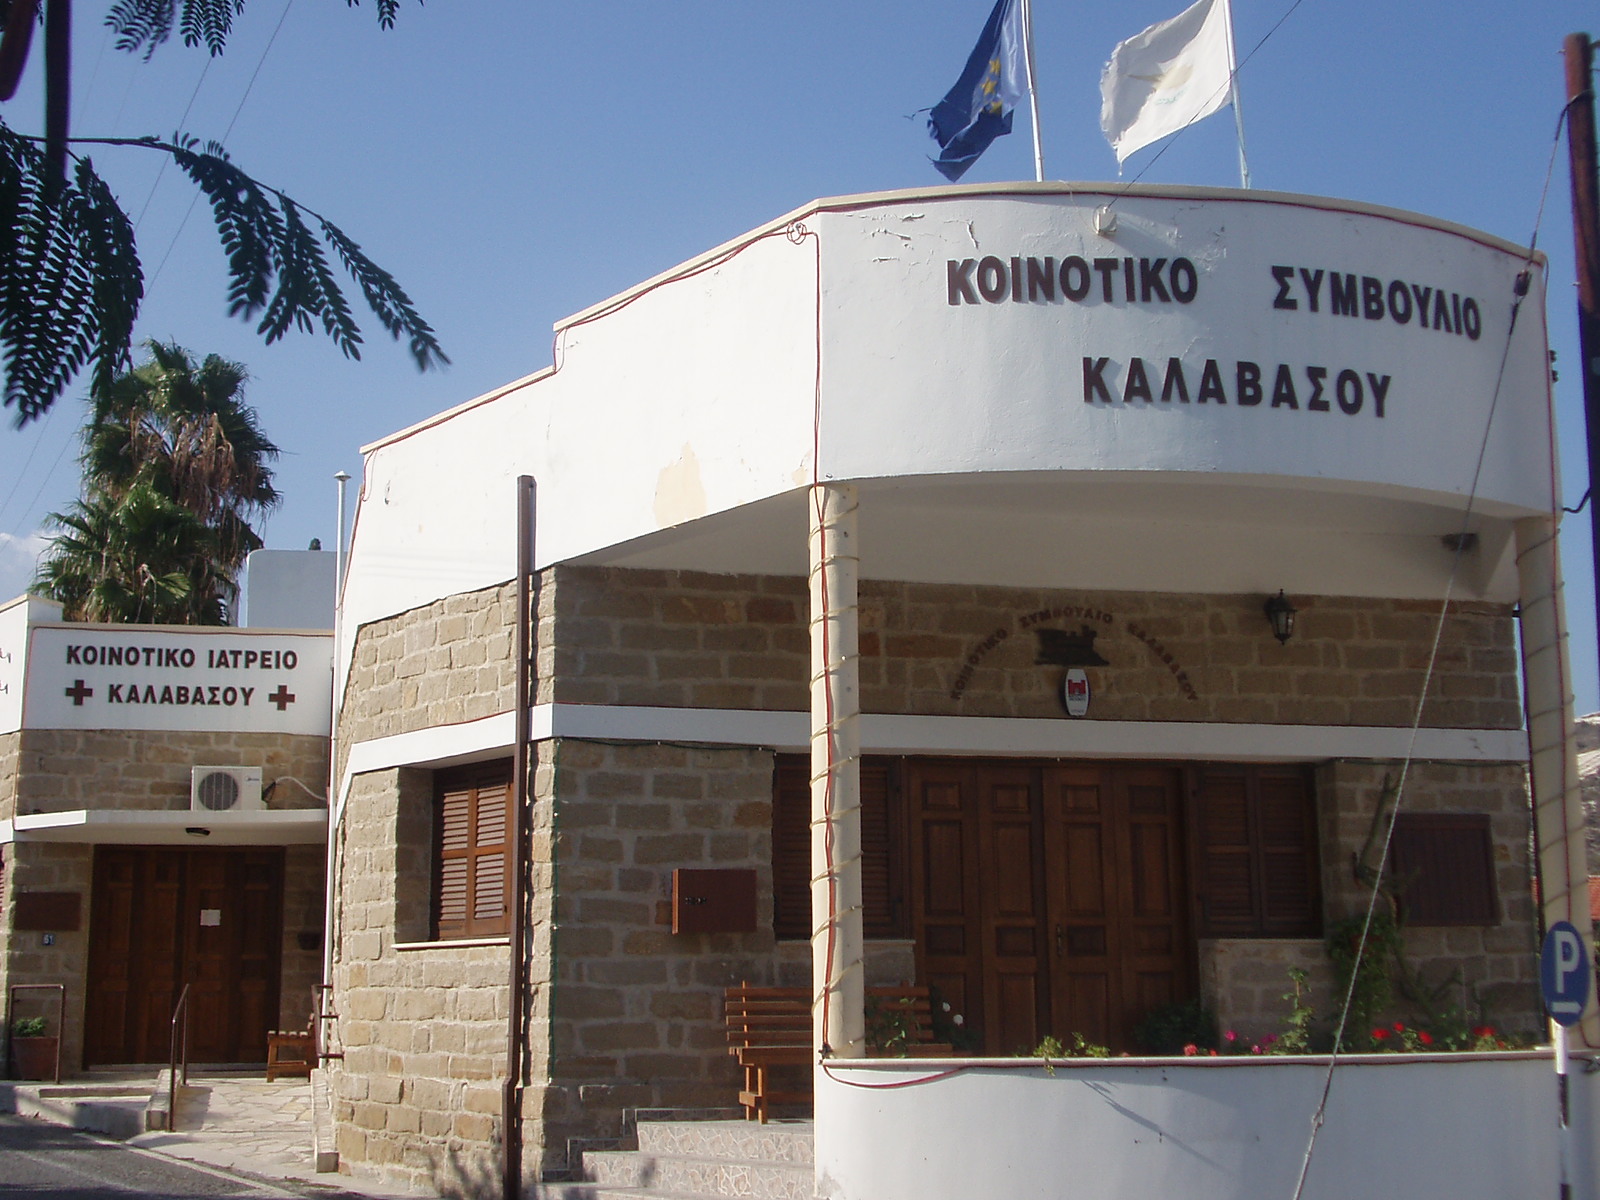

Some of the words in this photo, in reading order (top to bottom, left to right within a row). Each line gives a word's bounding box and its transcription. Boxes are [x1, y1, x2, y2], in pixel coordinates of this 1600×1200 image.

[947, 255, 1199, 305] ΚΟΙΝΟΤΙΚΟ
[1271, 265, 1481, 341] ΣΥΜΒΟΥΛΙΟ
[1082, 357, 1392, 418] ΚΑΛΑΒΑΣΟΥ
[66, 645, 195, 668] ΚΟΙΝΟΤΙΚΟ
[208, 649, 298, 670] ΙΑΤΡΕΙΟ
[108, 684, 255, 706] ΚΑΛΑΒΑΣΟΥ
[1554, 930, 1581, 994] P
